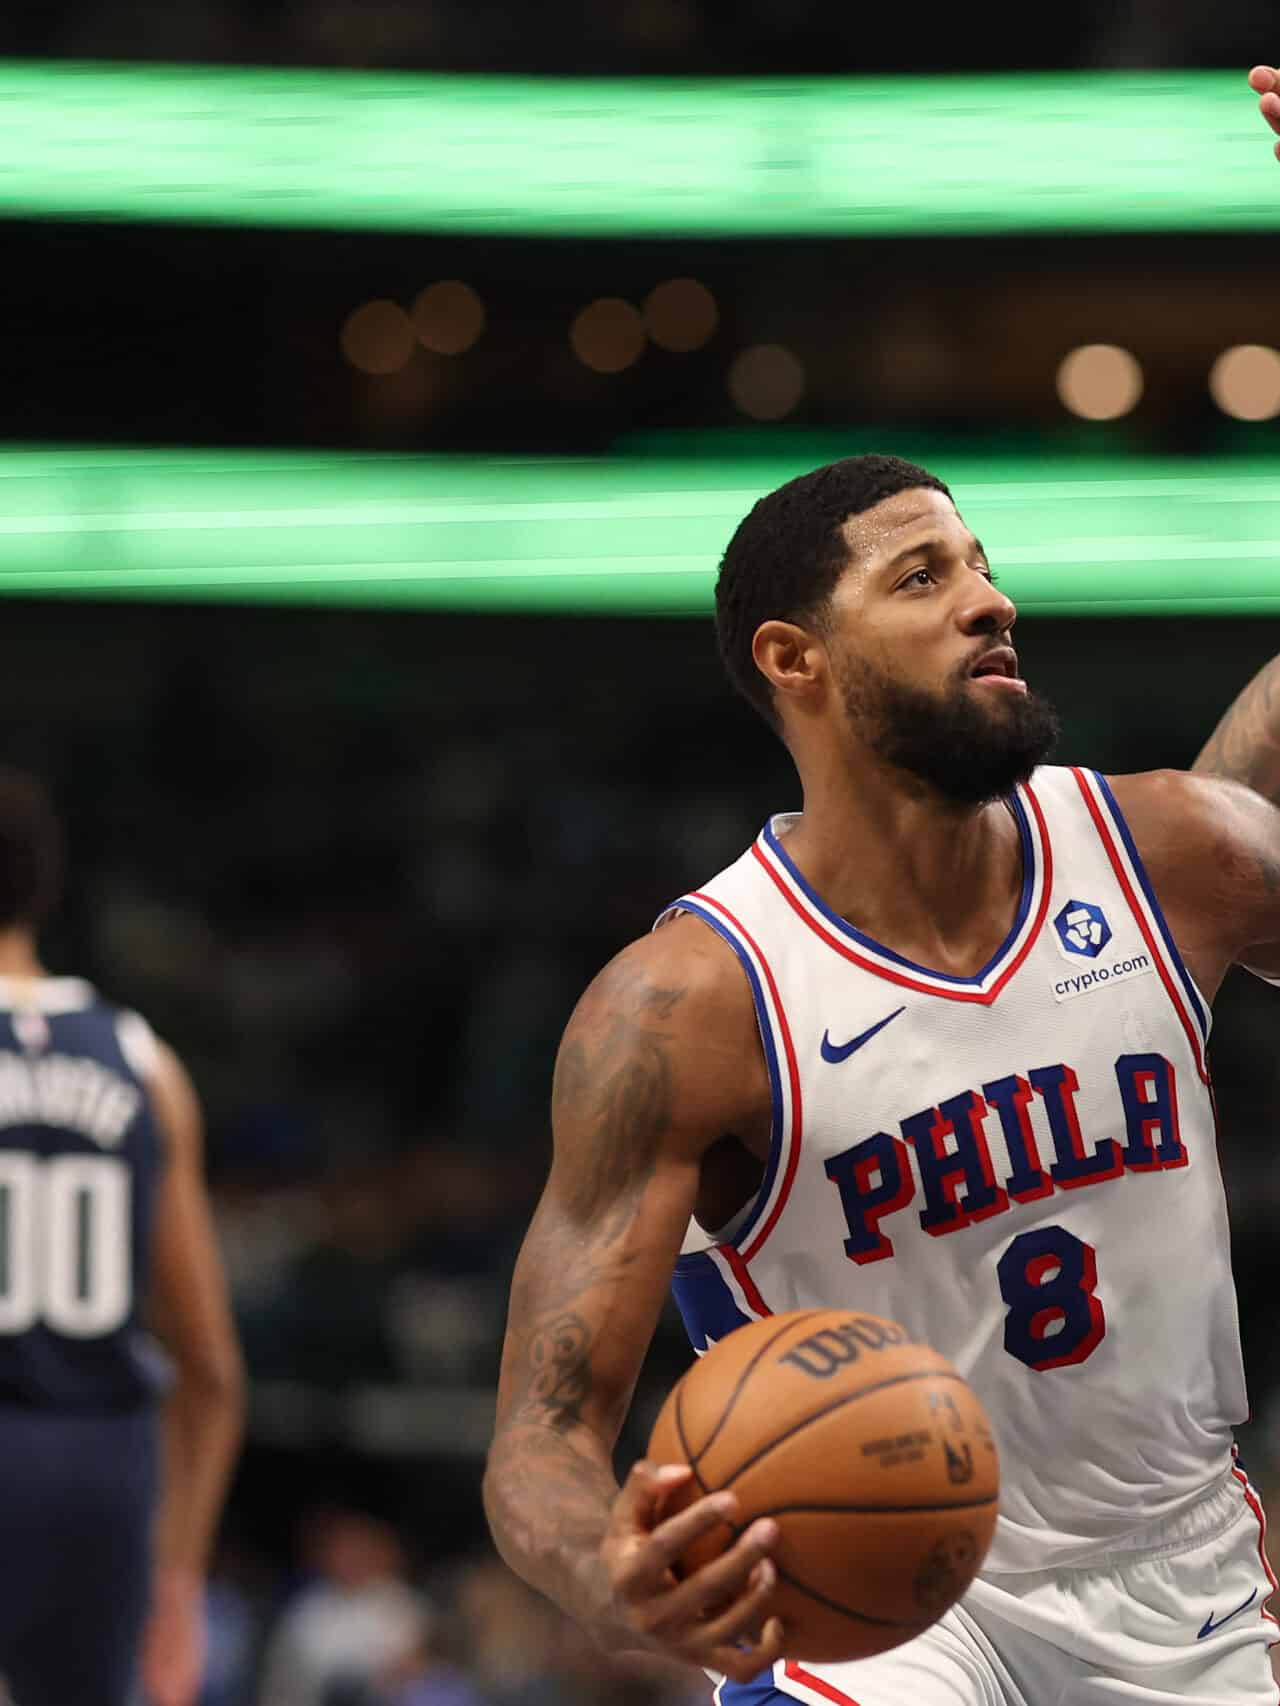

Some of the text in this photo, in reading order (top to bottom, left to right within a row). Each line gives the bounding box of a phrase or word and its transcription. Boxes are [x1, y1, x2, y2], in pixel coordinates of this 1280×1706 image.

[1055, 955, 1149, 995] crypto.com
[824, 1053, 1189, 1266] PHILA
[997, 1225, 1106, 1372] 8
